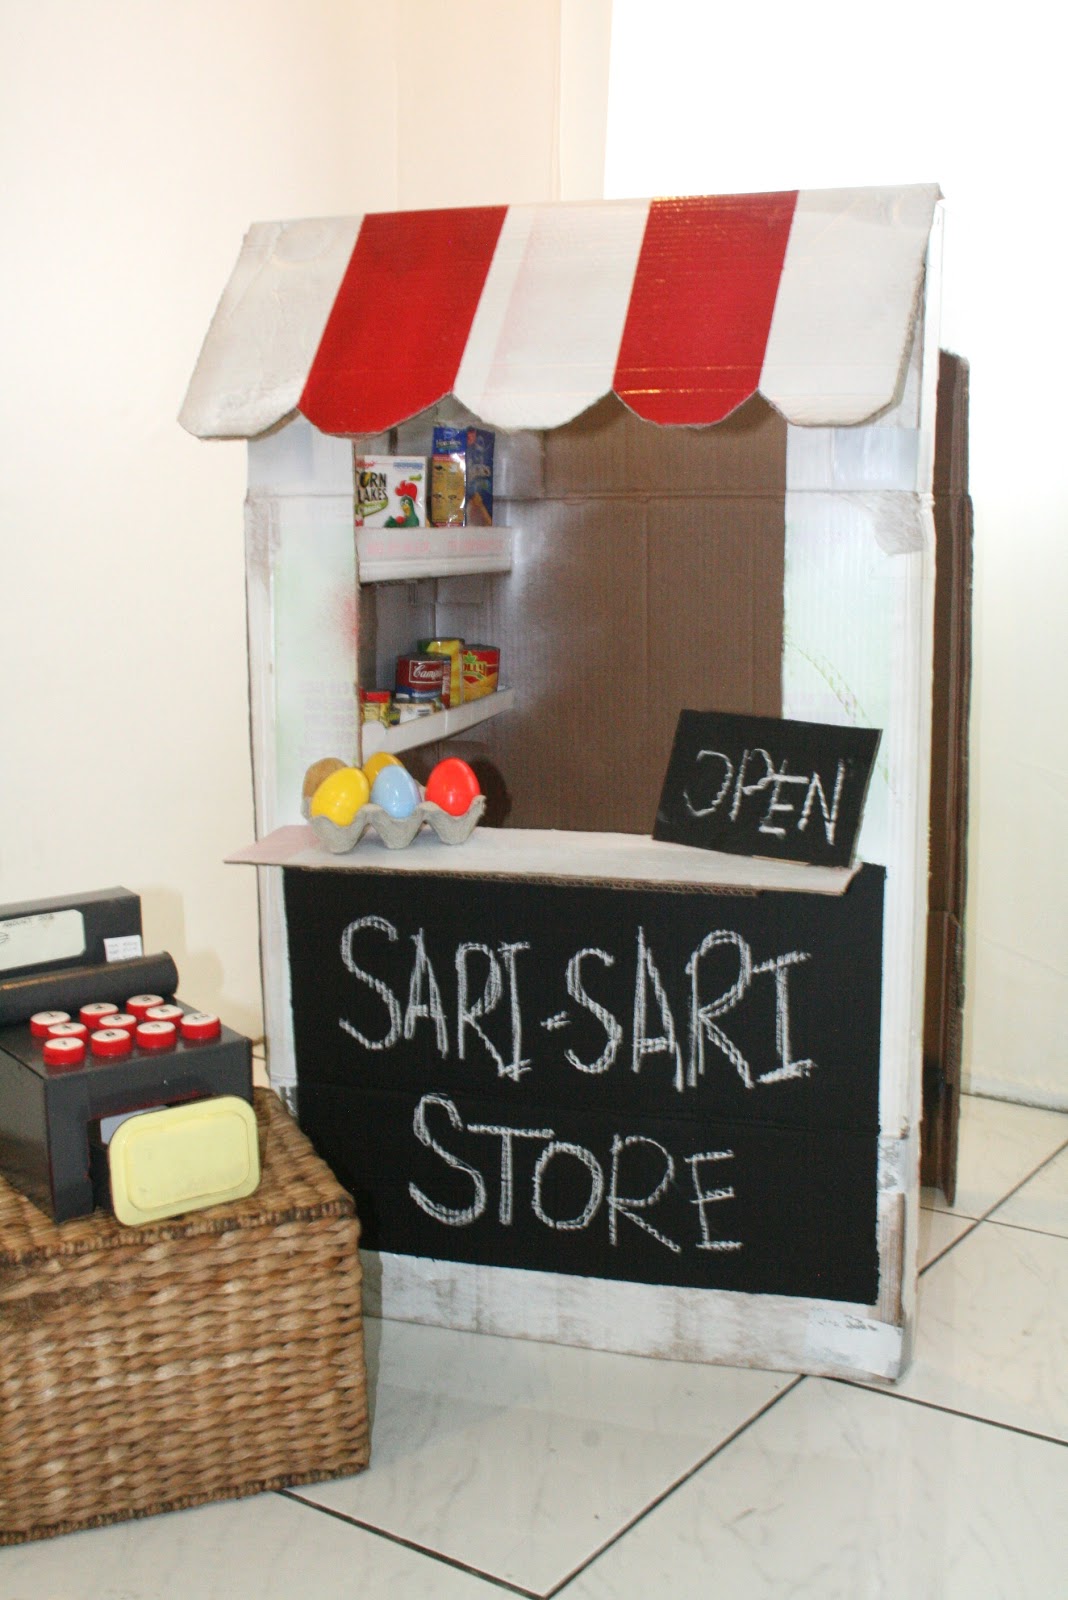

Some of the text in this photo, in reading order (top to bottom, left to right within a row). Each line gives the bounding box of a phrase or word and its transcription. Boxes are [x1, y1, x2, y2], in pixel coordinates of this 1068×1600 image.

[683, 748, 846, 846] OPEN
[338, 915, 816, 1093] SARI-SARI
[409, 1093, 743, 1254] STORE
